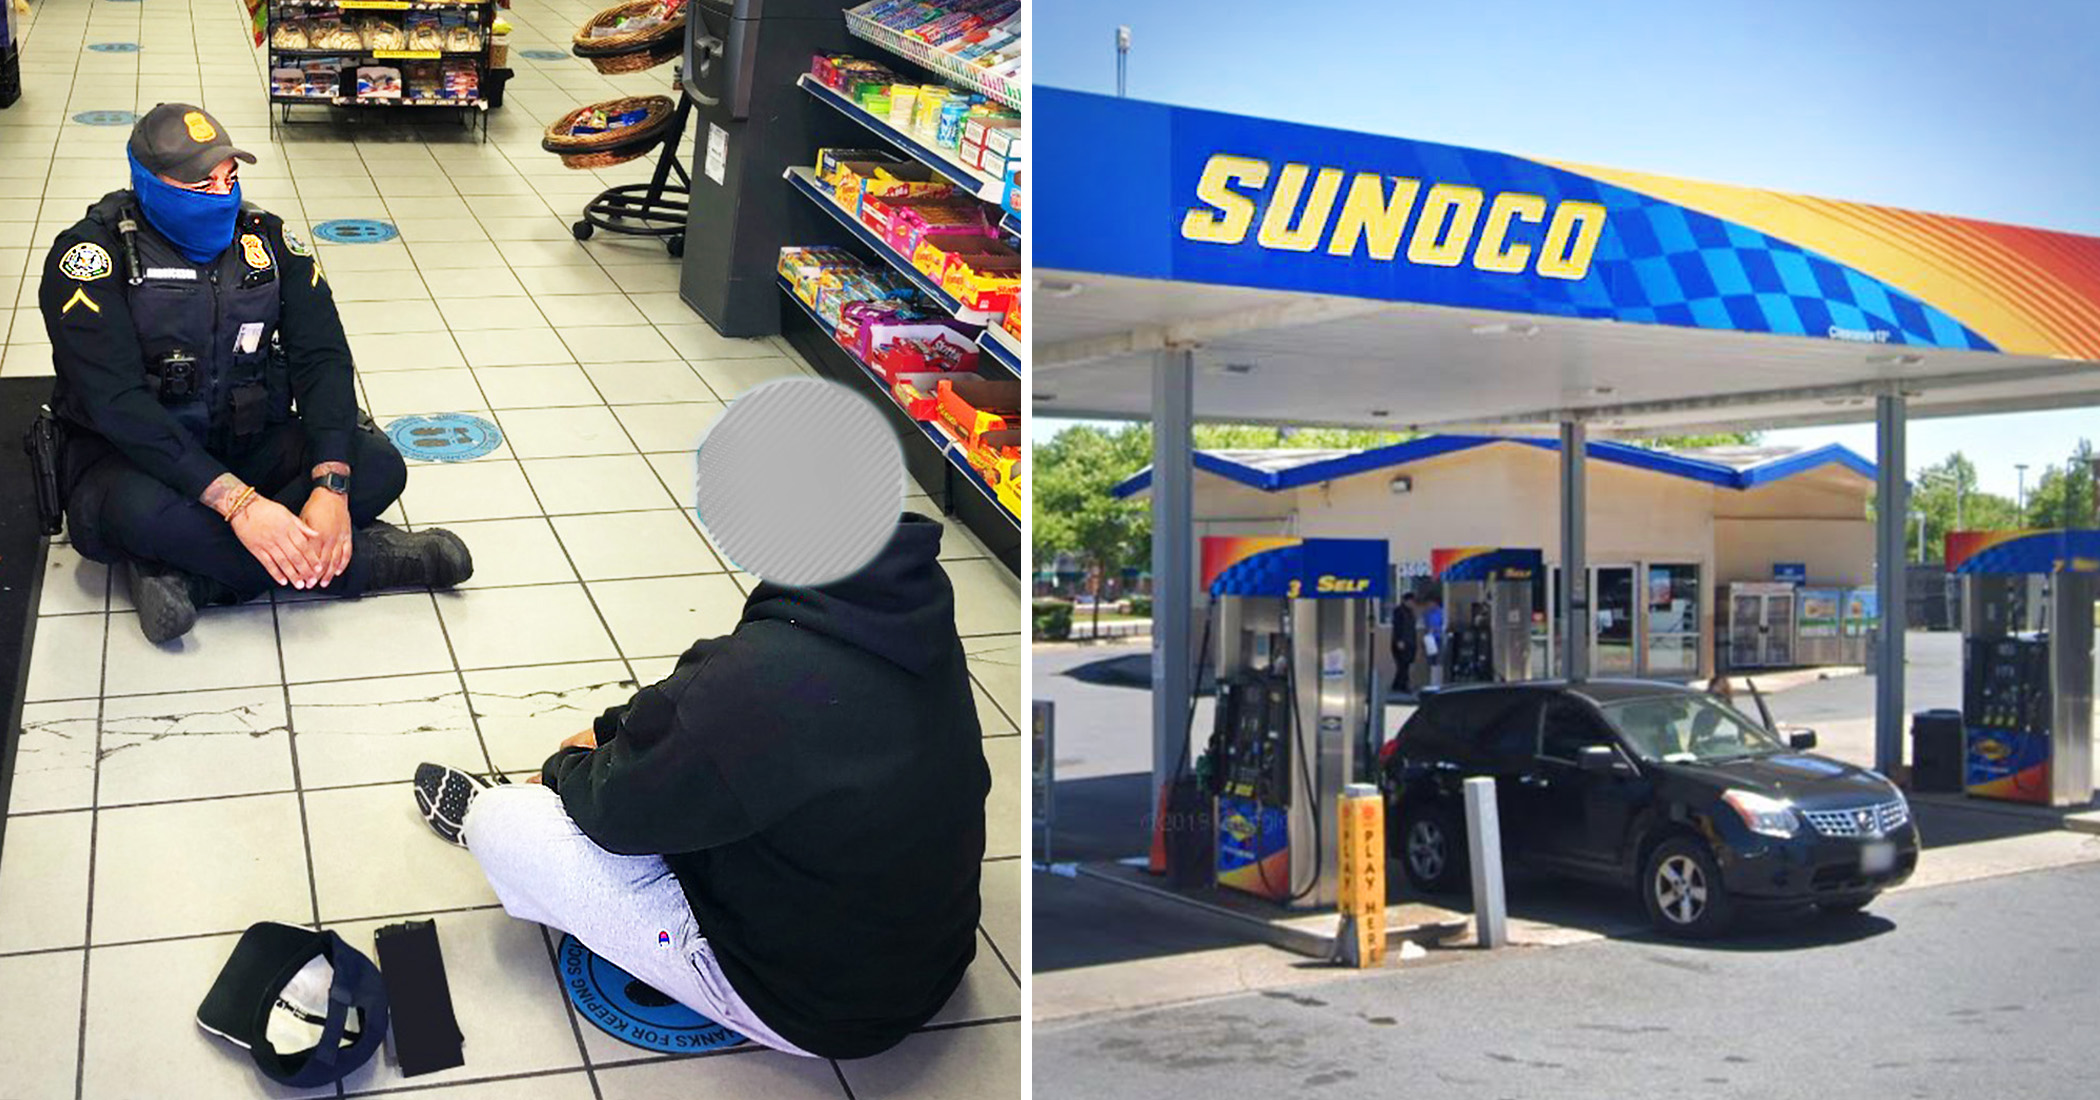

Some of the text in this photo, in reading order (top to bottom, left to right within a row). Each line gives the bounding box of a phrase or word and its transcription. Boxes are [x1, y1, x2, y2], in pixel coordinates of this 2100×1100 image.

[1181, 153, 1606, 281] SUNOCO
[1287, 579, 1301, 598] 3
[1364, 830, 1376, 890] PLAY
[567, 943, 583, 975] SOCI
[571, 979, 629, 1031] KEEPING
[632, 1027, 669, 1046] FOR
